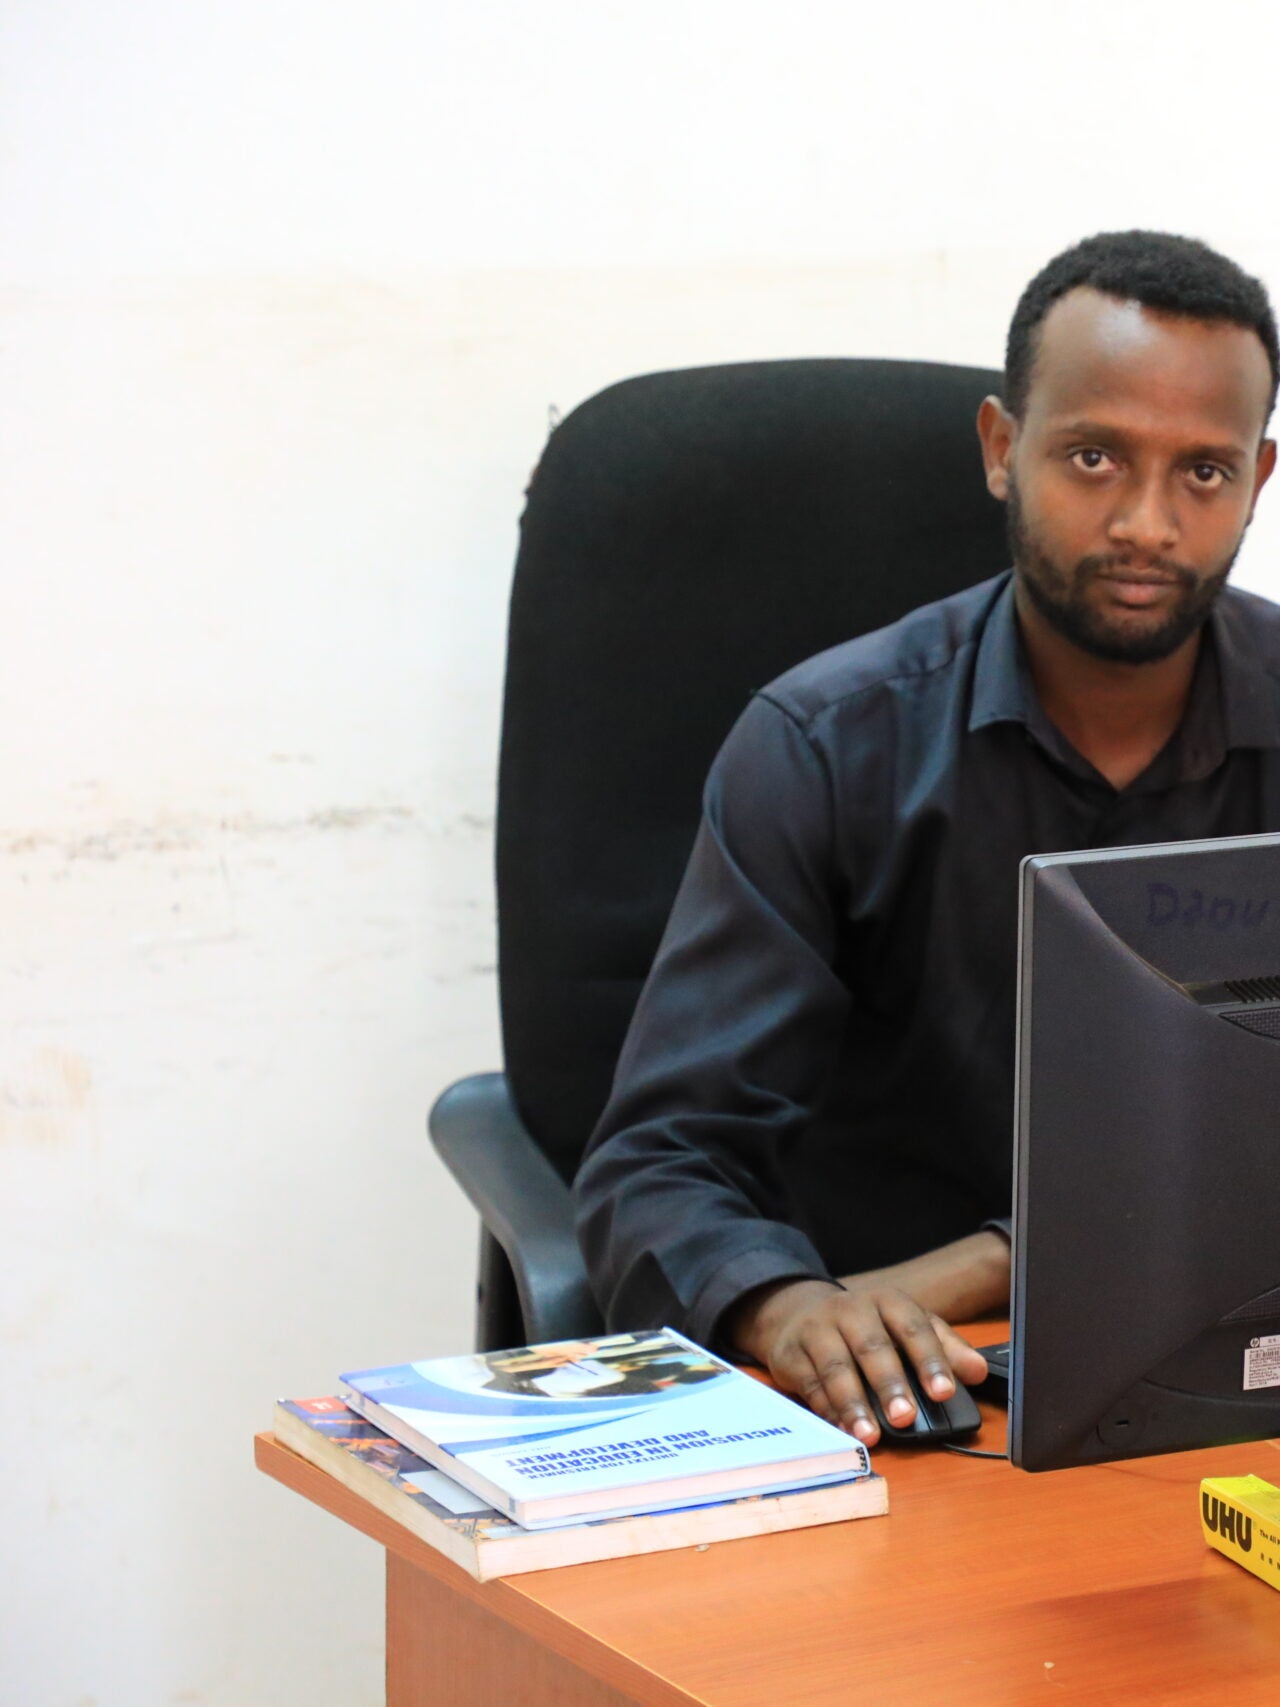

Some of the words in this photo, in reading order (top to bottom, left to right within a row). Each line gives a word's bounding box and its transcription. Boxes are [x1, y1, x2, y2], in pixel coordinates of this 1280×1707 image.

[663, 1428, 711, 1443] AND
[673, 1426, 793, 1451] INCLUSION
[505, 1438, 660, 1467] DEVELOPMENT
[513, 1450, 643, 1475] EDUCATION
[643, 1445, 670, 1456] IN
[1202, 1491, 1252, 1552] UHU
[1259, 1529, 1269, 1540] The
[1269, 1535, 1277, 1544] All
